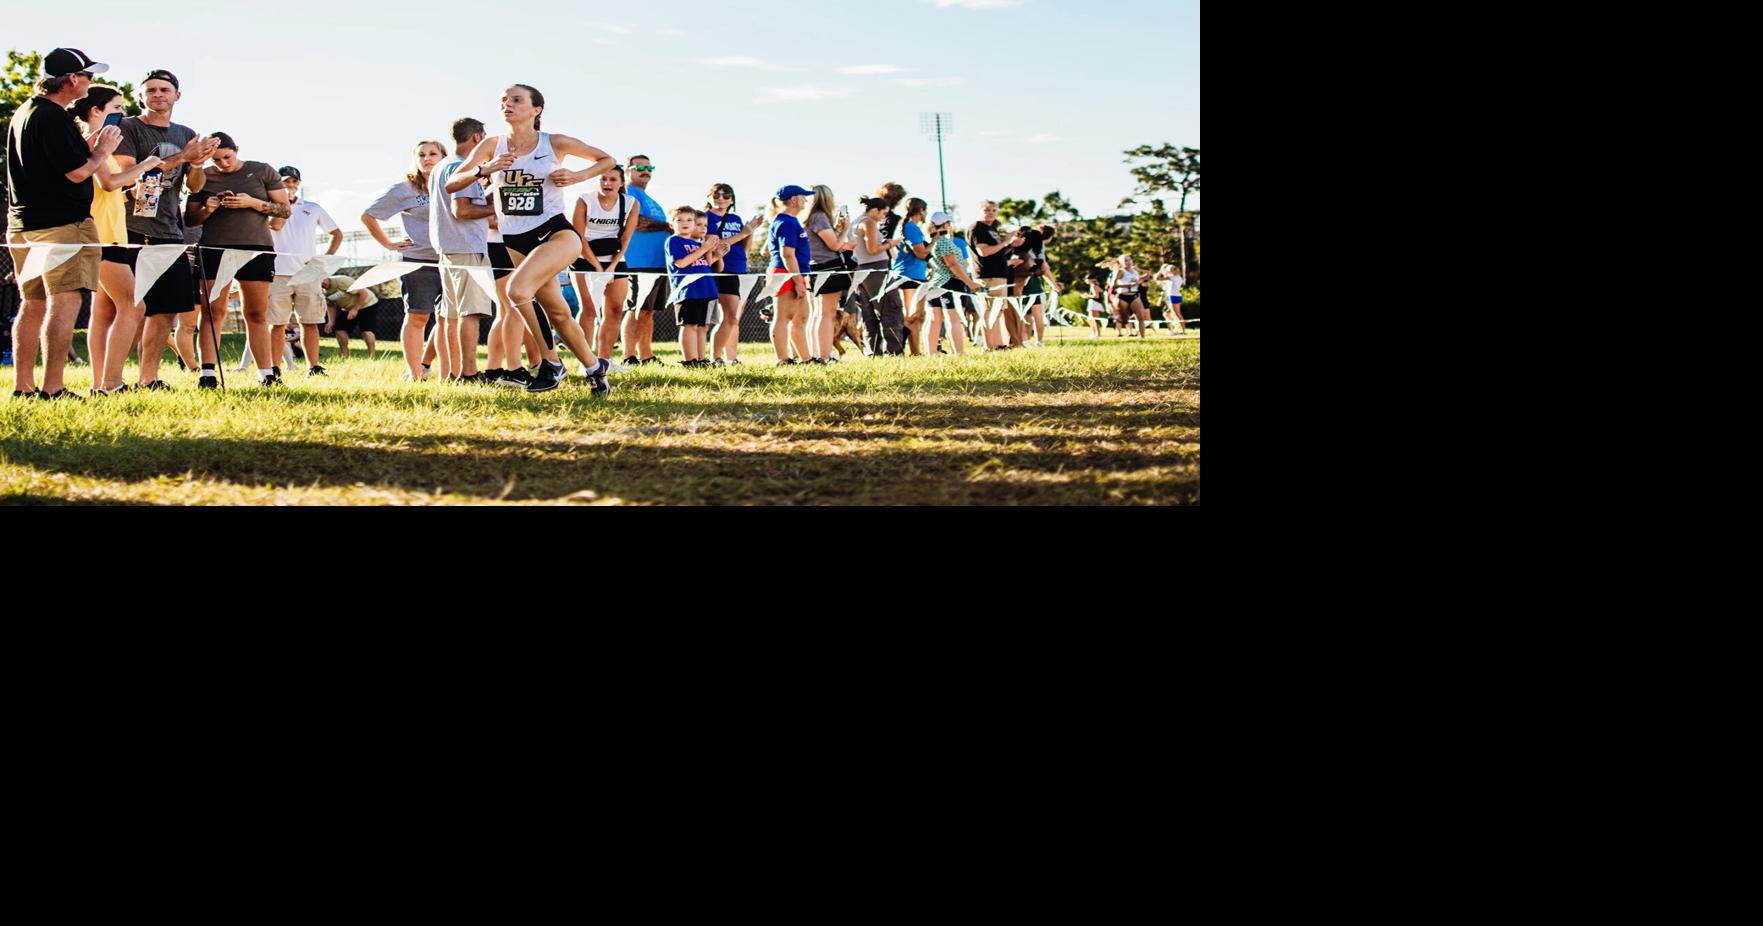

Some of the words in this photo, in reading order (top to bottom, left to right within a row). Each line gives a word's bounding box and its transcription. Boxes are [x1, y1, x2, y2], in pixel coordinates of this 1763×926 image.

[503, 169, 544, 187] UCF
[508, 197, 535, 210] 928
[589, 217, 623, 225] KNIGHT
